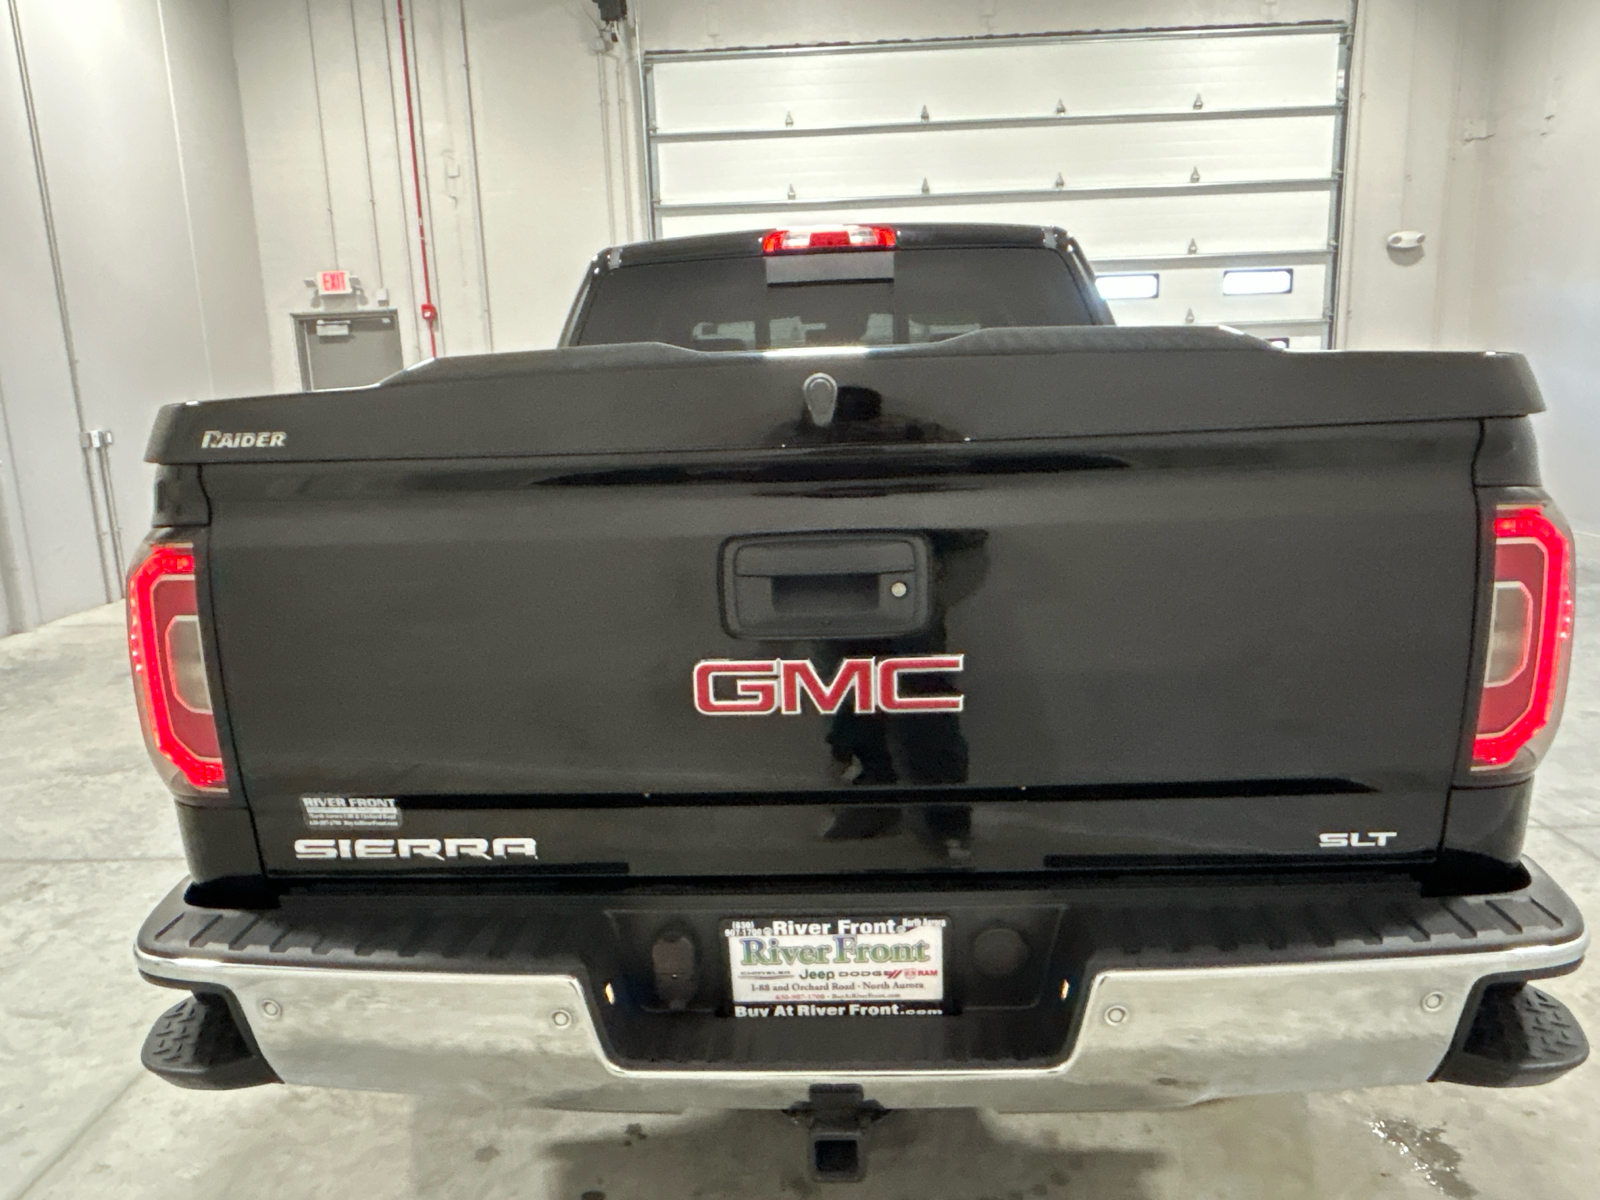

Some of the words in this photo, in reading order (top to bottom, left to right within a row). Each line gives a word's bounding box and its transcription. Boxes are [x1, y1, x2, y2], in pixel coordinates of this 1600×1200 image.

[322, 272, 346, 291] EXIT
[201, 430, 287, 449] RAIDER
[693, 653, 965, 716] GMC
[302, 797, 347, 807] RIVER
[348, 798, 396, 807] FRONT
[1318, 831, 1398, 848] SLT
[294, 837, 539, 861] SIERRA
[772, 920, 832, 935] River
[837, 919, 896, 934] Front
[739, 937, 833, 966] River
[831, 933, 930, 964] Front
[798, 969, 835, 981] Jeep
[772, 983, 790, 991] and
[791, 982, 829, 991] Orchard
[831, 982, 856, 990] Road
[862, 981, 890, 990] North
[892, 981, 925, 989] Aurora
[734, 1005, 770, 1018] Buy
[773, 1004, 795, 1017] At
[796, 1004, 847, 1017] River
